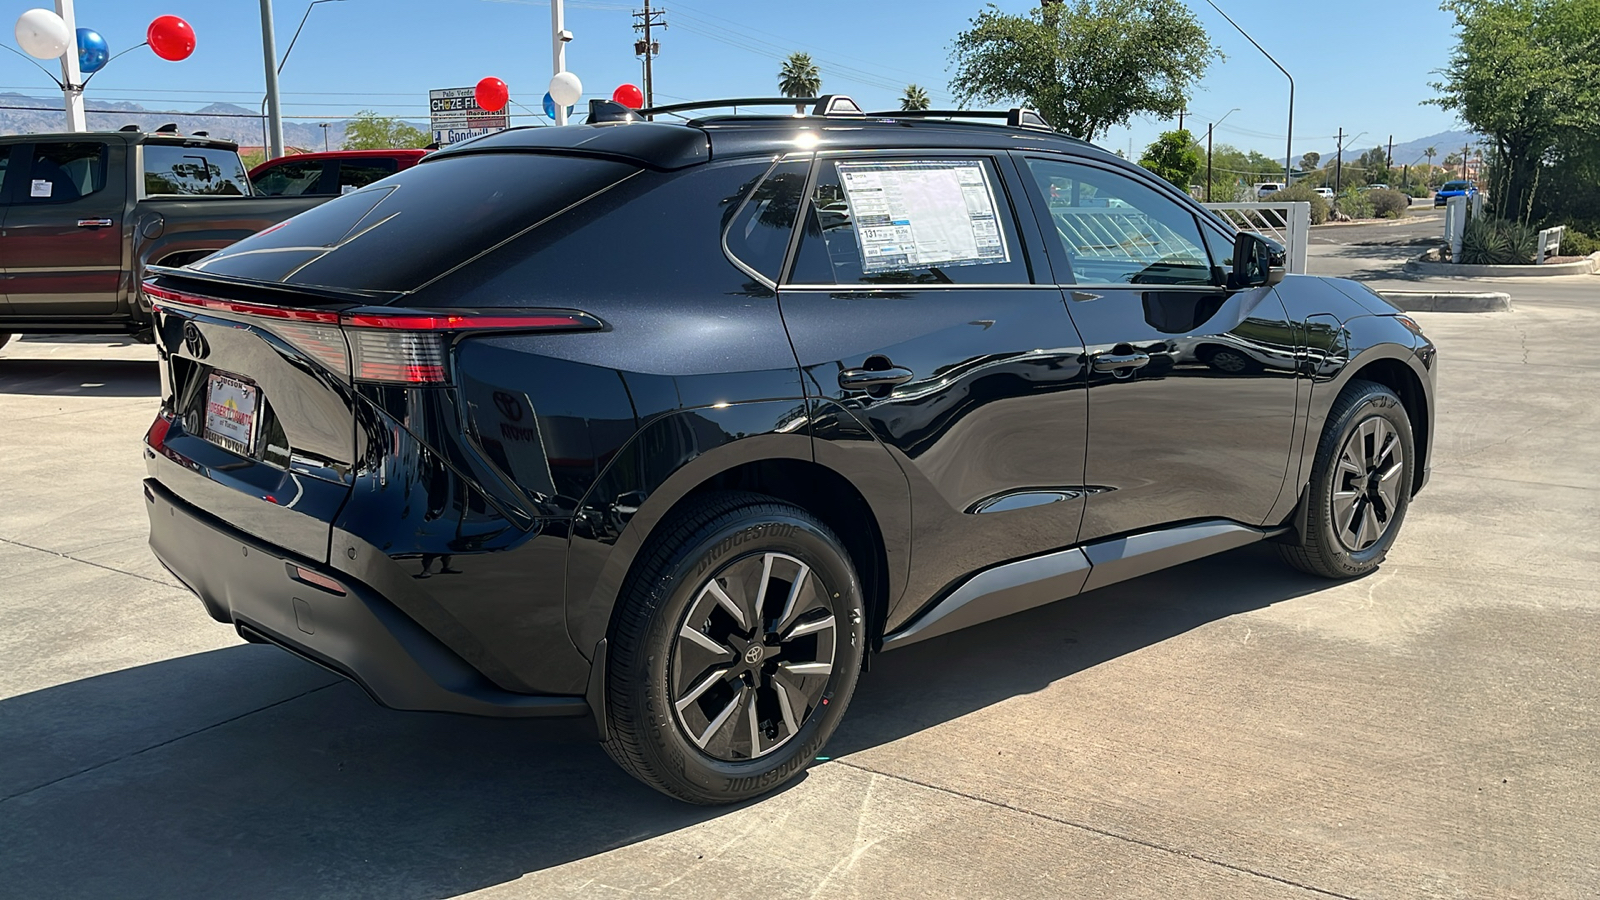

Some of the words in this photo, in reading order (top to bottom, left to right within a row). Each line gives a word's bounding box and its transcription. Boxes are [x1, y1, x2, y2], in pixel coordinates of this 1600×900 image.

[442, 90, 454, 98] Palo
[457, 89, 473, 97] Verde
[448, 127, 489, 143] Goodwill
[864, 229, 877, 239] 131
[220, 377, 243, 390] TUCSON
[209, 402, 230, 418] DESERT
[231, 409, 252, 426] TOYOTA
[225, 420, 238, 430] Tucson
[205, 429, 222, 446] DESERT
[224, 438, 247, 454] TOYOTA
[696, 522, 800, 577] BRIDGESTONE
